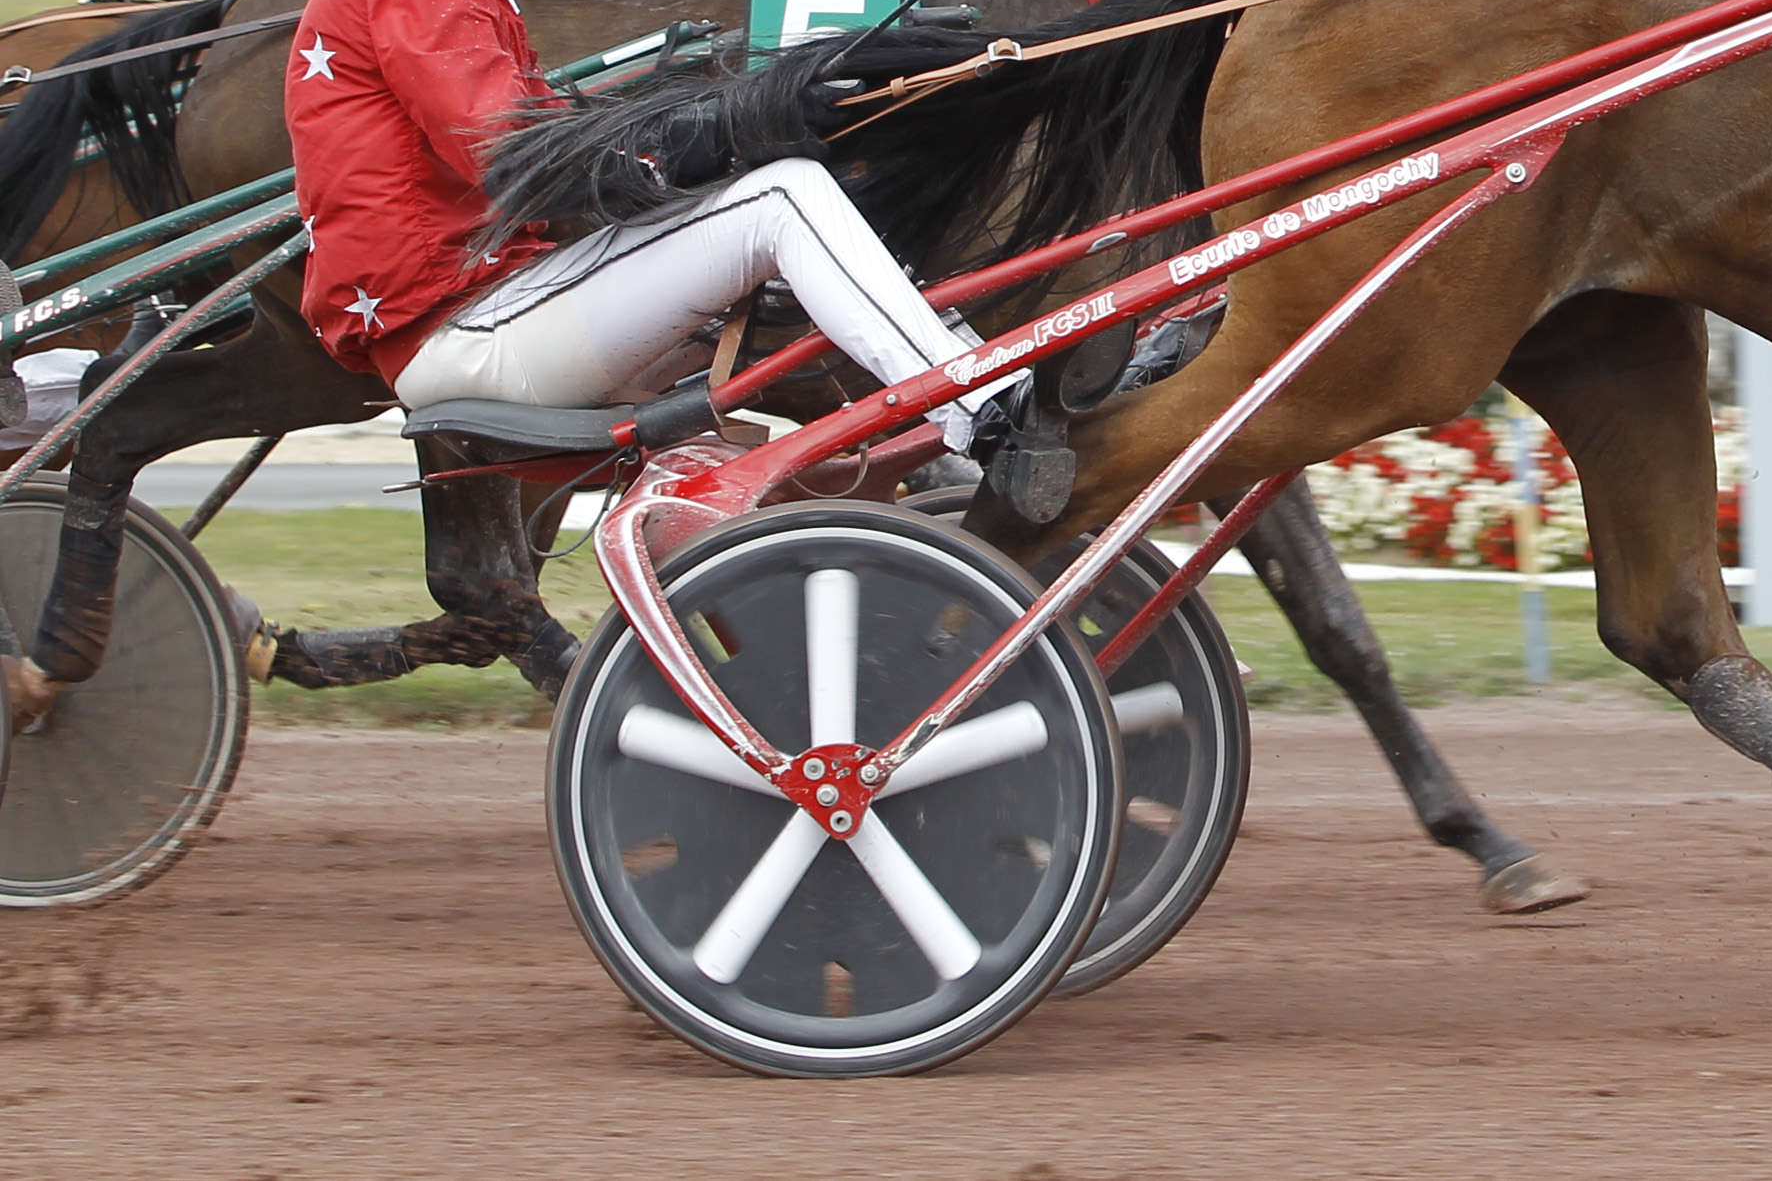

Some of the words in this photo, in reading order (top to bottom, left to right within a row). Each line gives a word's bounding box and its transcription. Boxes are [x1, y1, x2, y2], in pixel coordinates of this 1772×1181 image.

[1168, 230, 1261, 285] Ecurie
[1263, 209, 1301, 240] de
[1303, 151, 1440, 222] Mongochy
